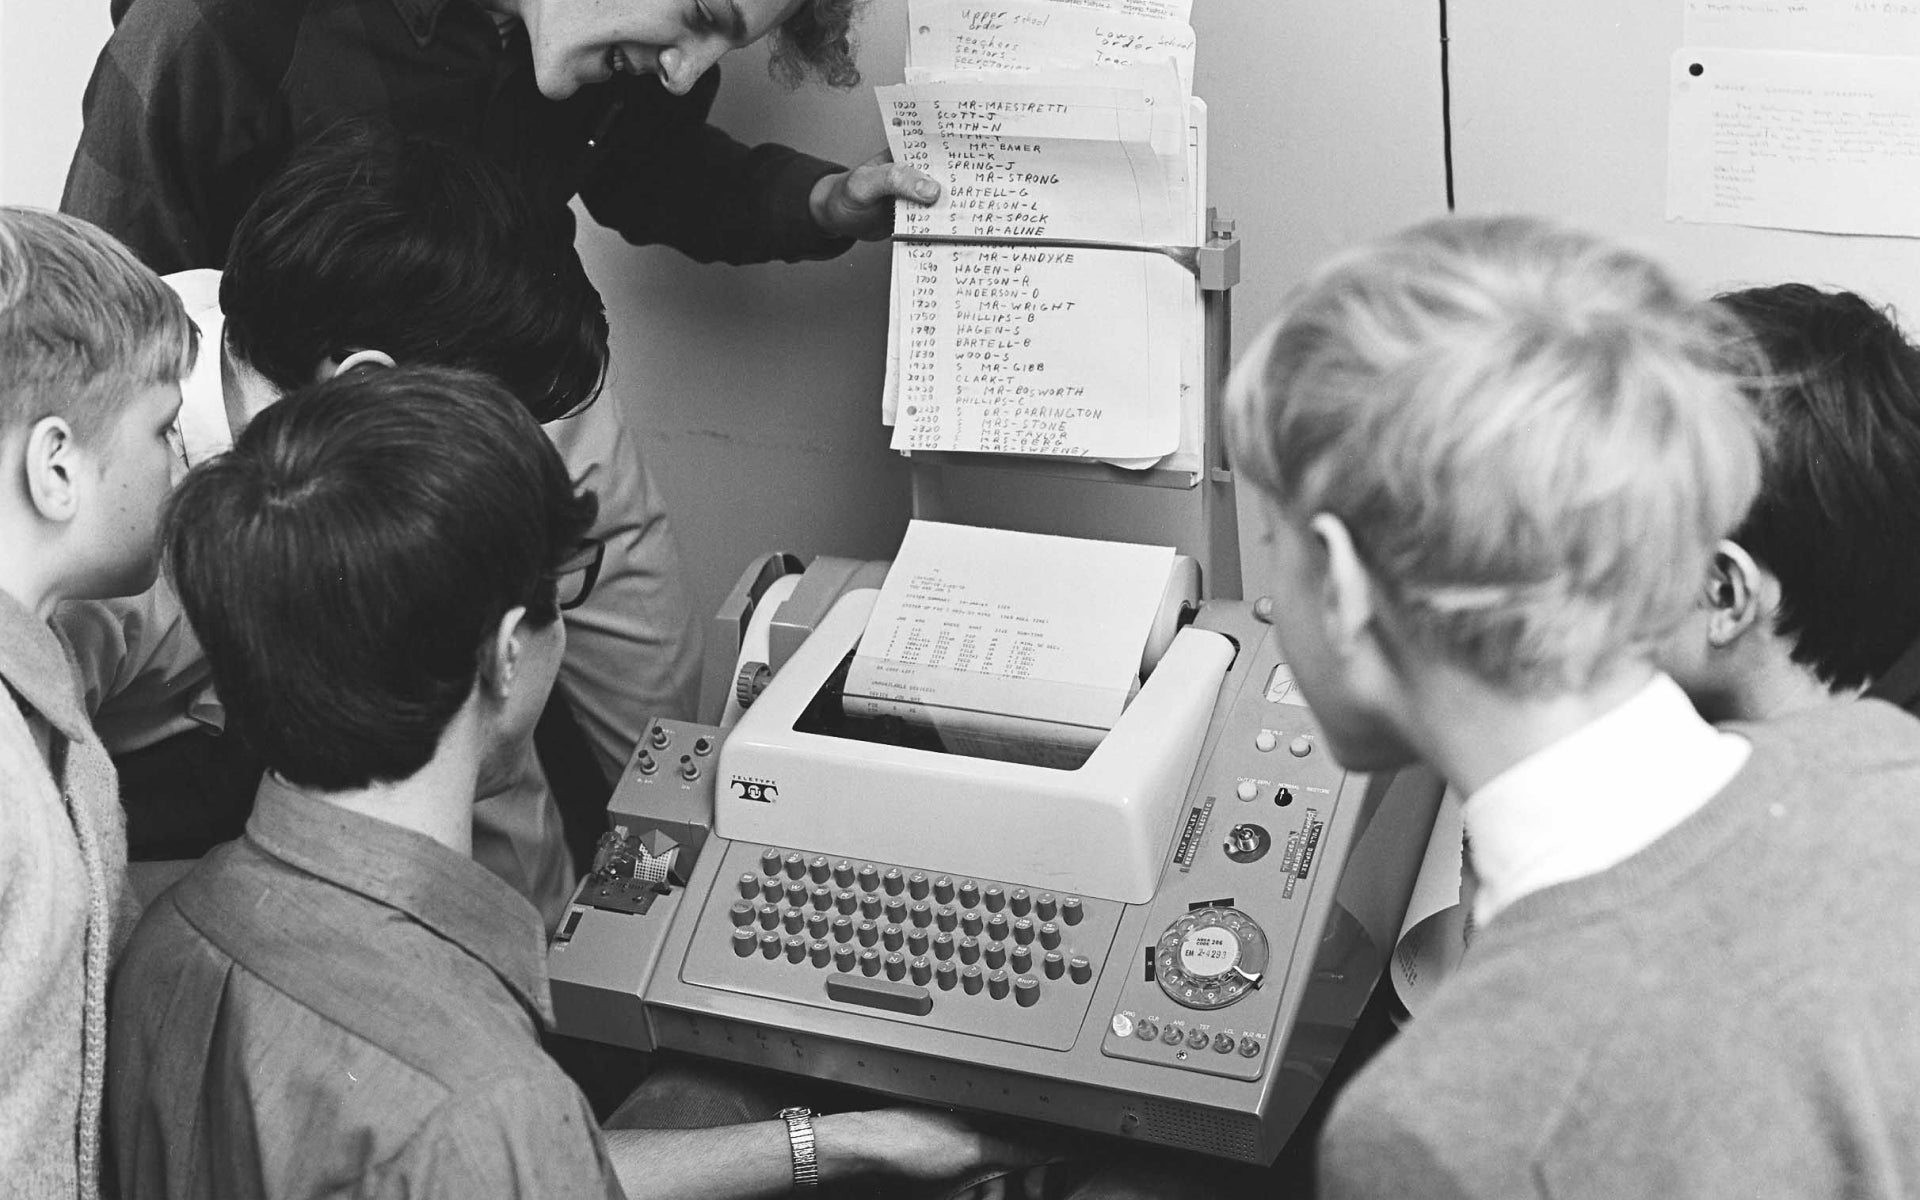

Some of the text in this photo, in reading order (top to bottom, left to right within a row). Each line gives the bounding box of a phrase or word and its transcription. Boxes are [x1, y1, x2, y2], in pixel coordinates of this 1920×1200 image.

[893, 101, 916, 109] 1020
[934, 101, 940, 109] S
[938, 111, 996, 121] SCOTT-J
[938, 121, 1002, 132] SMITH-N
[904, 141, 927, 149] 1220
[943, 141, 949, 150] S
[949, 152, 995, 161] HILL-K
[947, 161, 1016, 171] SPRING-J
[950, 173, 1060, 185] S MR-STRONG
[951, 187, 1029, 197] BARTELL-G
[949, 200, 1038, 210] ANDERSON-L
[906, 213, 1049, 224] 1420 S MR-SPOCK
[951, 226, 958, 235] S
[953, 252, 959, 261] S
[979, 252, 1075, 264] MR-VANDYKE
[955, 300, 961, 309] S
[979, 300, 1076, 311] MR-WRIGHT
[957, 311, 1035, 323] PHILLIPS-B
[956, 338, 1031, 349] BARTELL-B
[957, 363, 962, 371] S
[981, 362, 1044, 372] MR-GIBB
[956, 374, 1015, 384] CLARK-T
[956, 385, 962, 395] S
